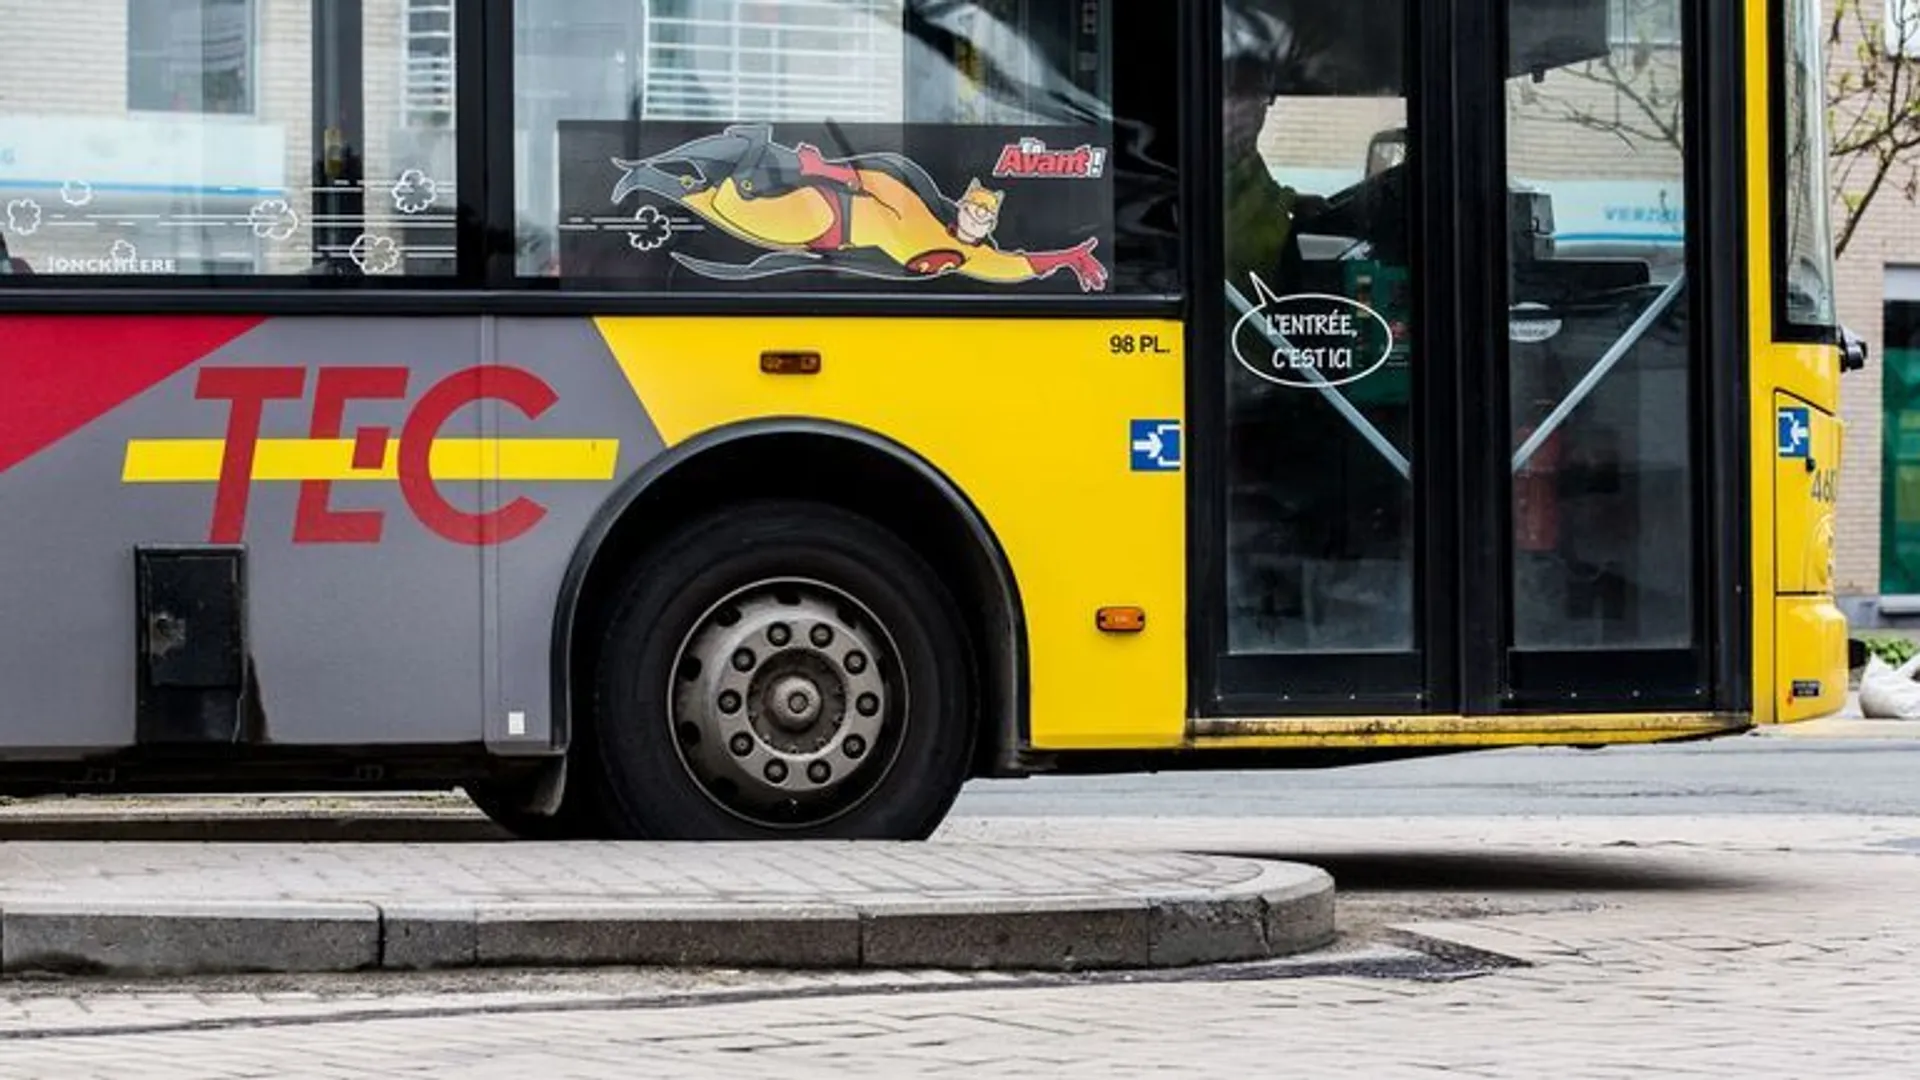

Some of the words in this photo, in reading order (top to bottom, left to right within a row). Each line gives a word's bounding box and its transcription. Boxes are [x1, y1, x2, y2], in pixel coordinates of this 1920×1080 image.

[1266, 309, 1358, 338] L'ENTRÉE,
[1109, 335, 1135, 354] 98
[1140, 335, 1171, 354] PL.
[1328, 348, 1352, 369] ICI
[194, 364, 560, 546] TEC
